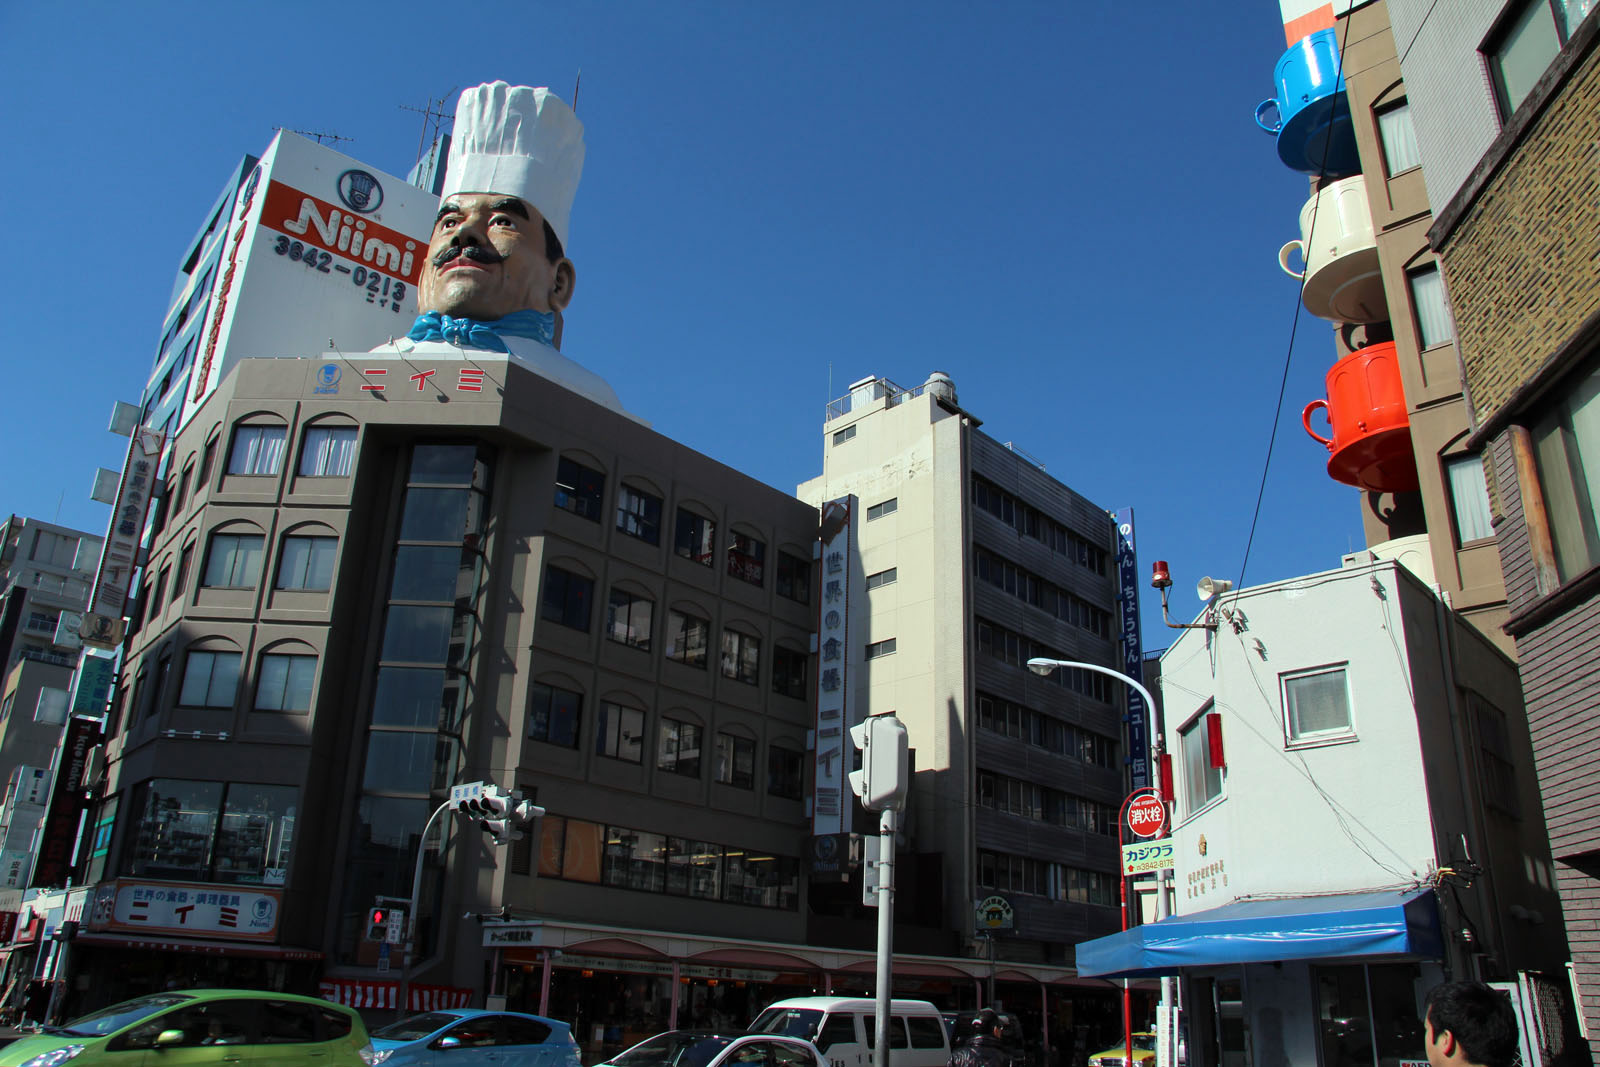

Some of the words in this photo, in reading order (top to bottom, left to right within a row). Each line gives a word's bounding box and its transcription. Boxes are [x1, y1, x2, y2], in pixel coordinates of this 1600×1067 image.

[283, 198, 416, 277] Niimi
[274, 236, 407, 301] 3842-0213
[366, 292, 401, 313] ニイミ
[360, 367, 486, 393] ニイミ
[1131, 805, 1161, 825] 消火栓
[1126, 844, 1173, 862] カジワラ
[129, 901, 239, 928] ニイミ
